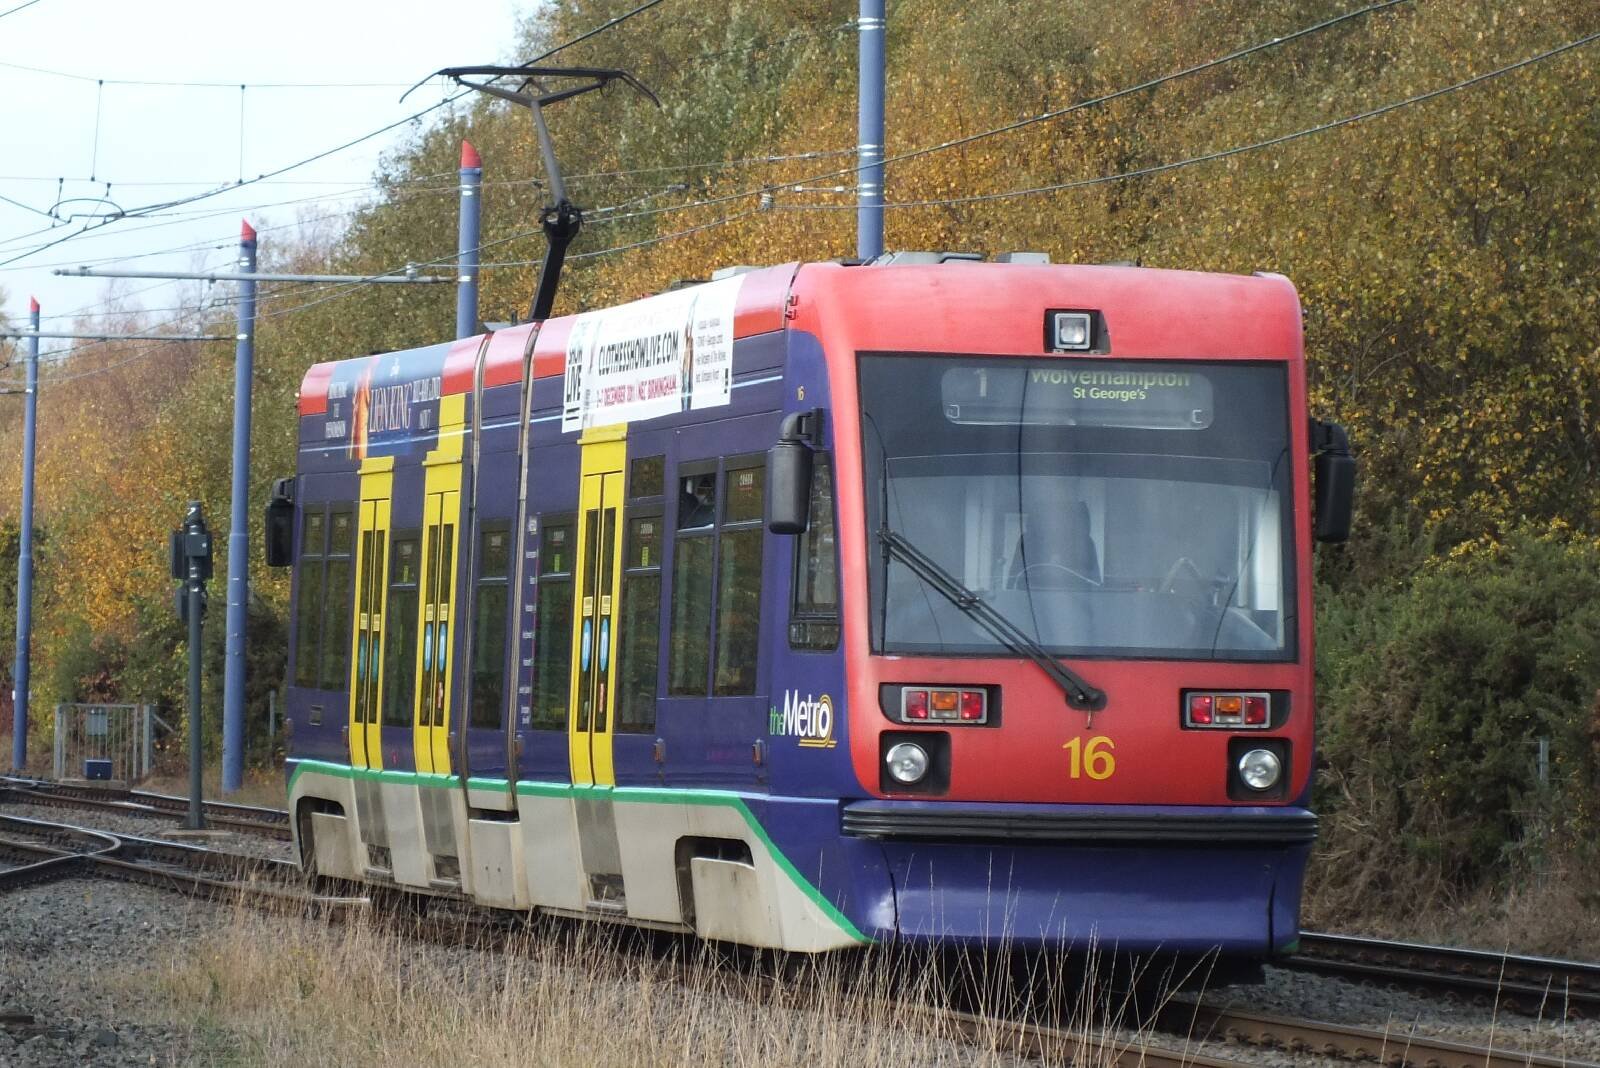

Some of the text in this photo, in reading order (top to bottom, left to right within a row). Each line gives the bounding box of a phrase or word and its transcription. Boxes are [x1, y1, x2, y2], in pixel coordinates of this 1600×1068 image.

[598, 330, 680, 376] CLOTHESSHOWLIVE.COM
[566, 364, 582, 403] LIVE
[1031, 368, 1191, 389] Wolverhampton
[1073, 387, 1146, 402] St George's
[1062, 735, 1116, 780] 16
